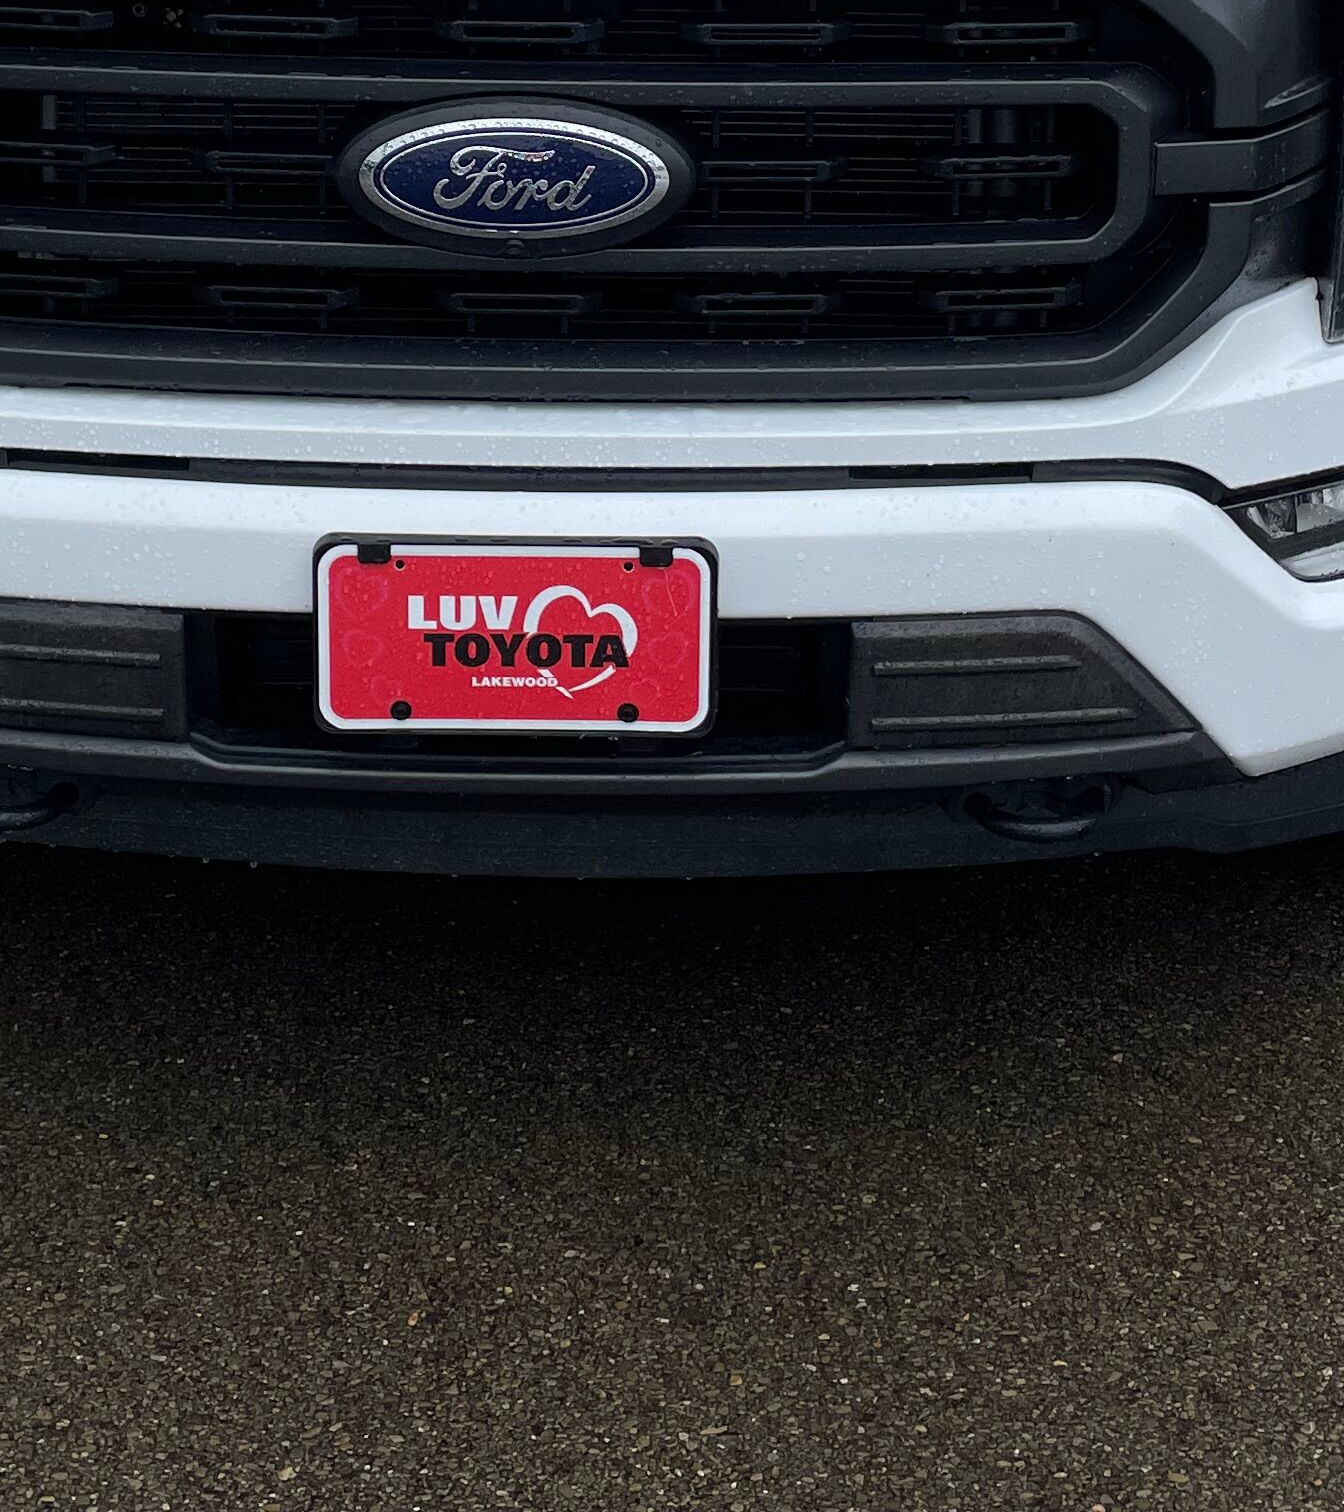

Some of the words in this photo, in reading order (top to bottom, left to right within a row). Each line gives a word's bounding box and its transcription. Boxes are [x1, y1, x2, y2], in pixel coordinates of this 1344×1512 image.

[433, 145, 598, 212] Ford
[407, 594, 518, 631] LUV
[423, 633, 631, 668] TOYOTA
[471, 676, 560, 689] LAKEWOOD
